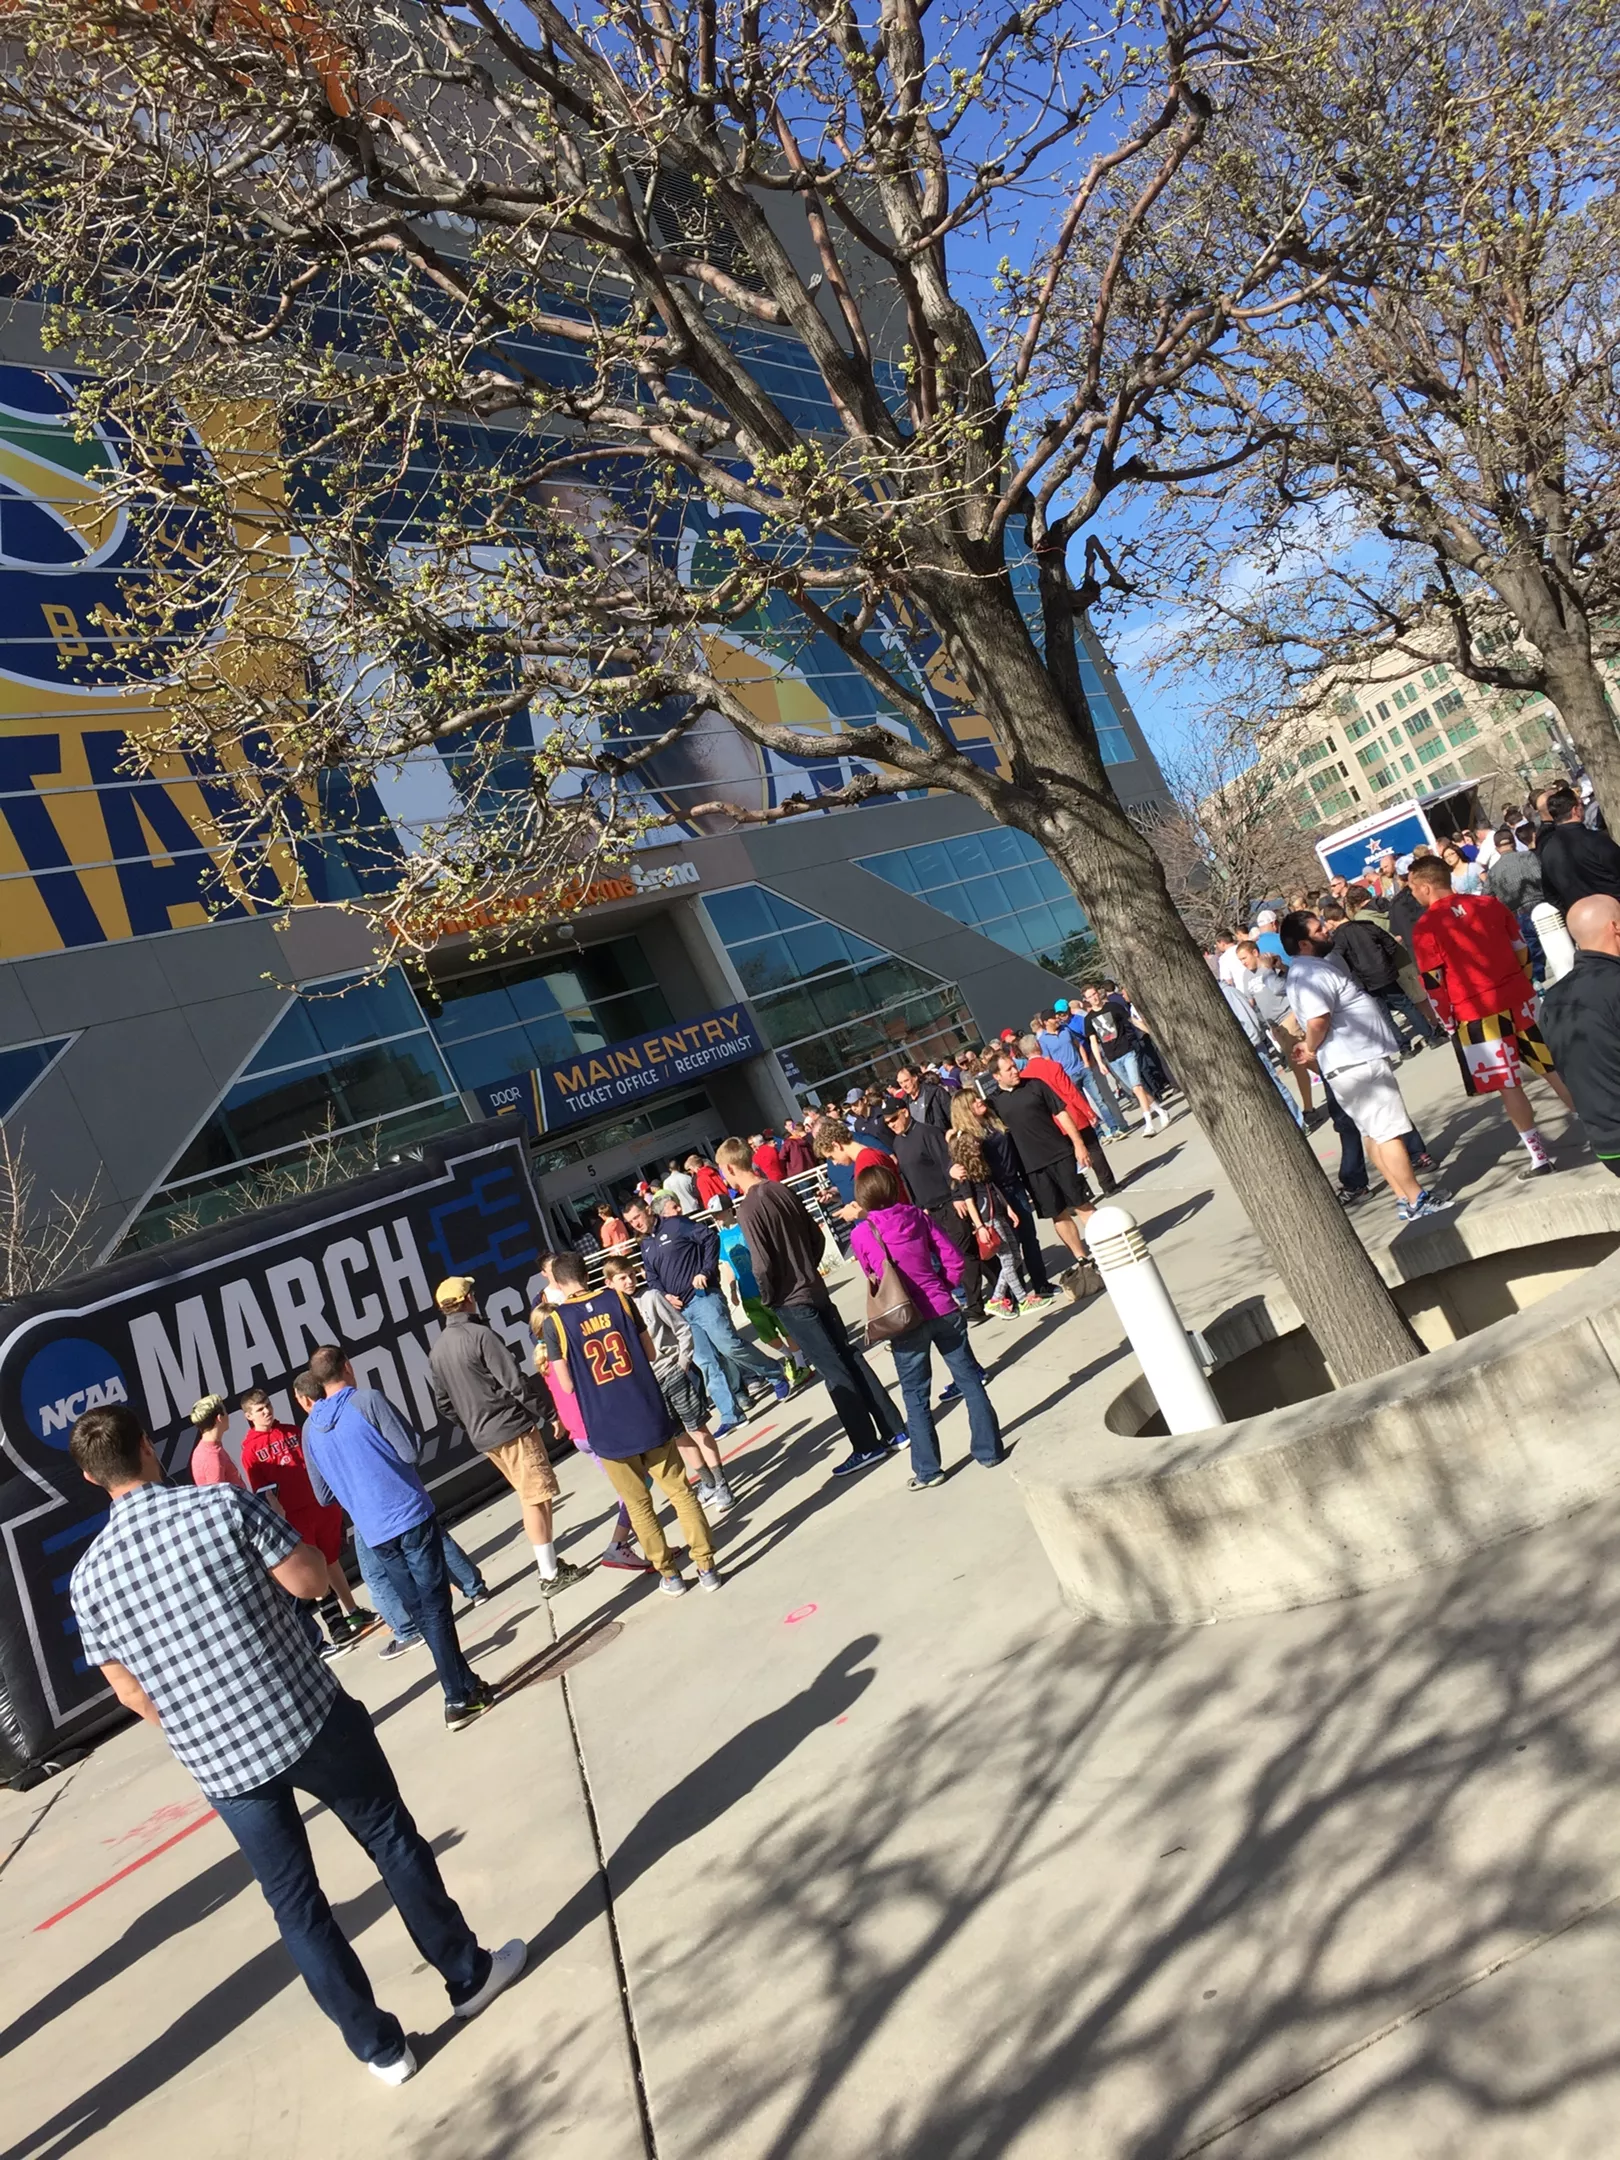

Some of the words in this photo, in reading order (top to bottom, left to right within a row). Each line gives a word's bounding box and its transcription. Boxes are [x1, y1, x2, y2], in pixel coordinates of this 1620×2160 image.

[1450, 904, 1467, 917] M
[553, 1050, 642, 1095] MAIN
[643, 1012, 739, 1063] ENTRY
[565, 1084, 613, 1112] TICKET
[616, 1069, 659, 1095] OFFICE
[675, 1035, 752, 1074] RECEPTIONIST
[490, 1086, 522, 1107] DOOR
[587, 1164, 597, 1177] 5
[128, 1217, 434, 1431] MARCH
[580, 1313, 612, 1337] JAMES
[583, 1331, 633, 1386] 23
[38, 1376, 128, 1437] NCAA
